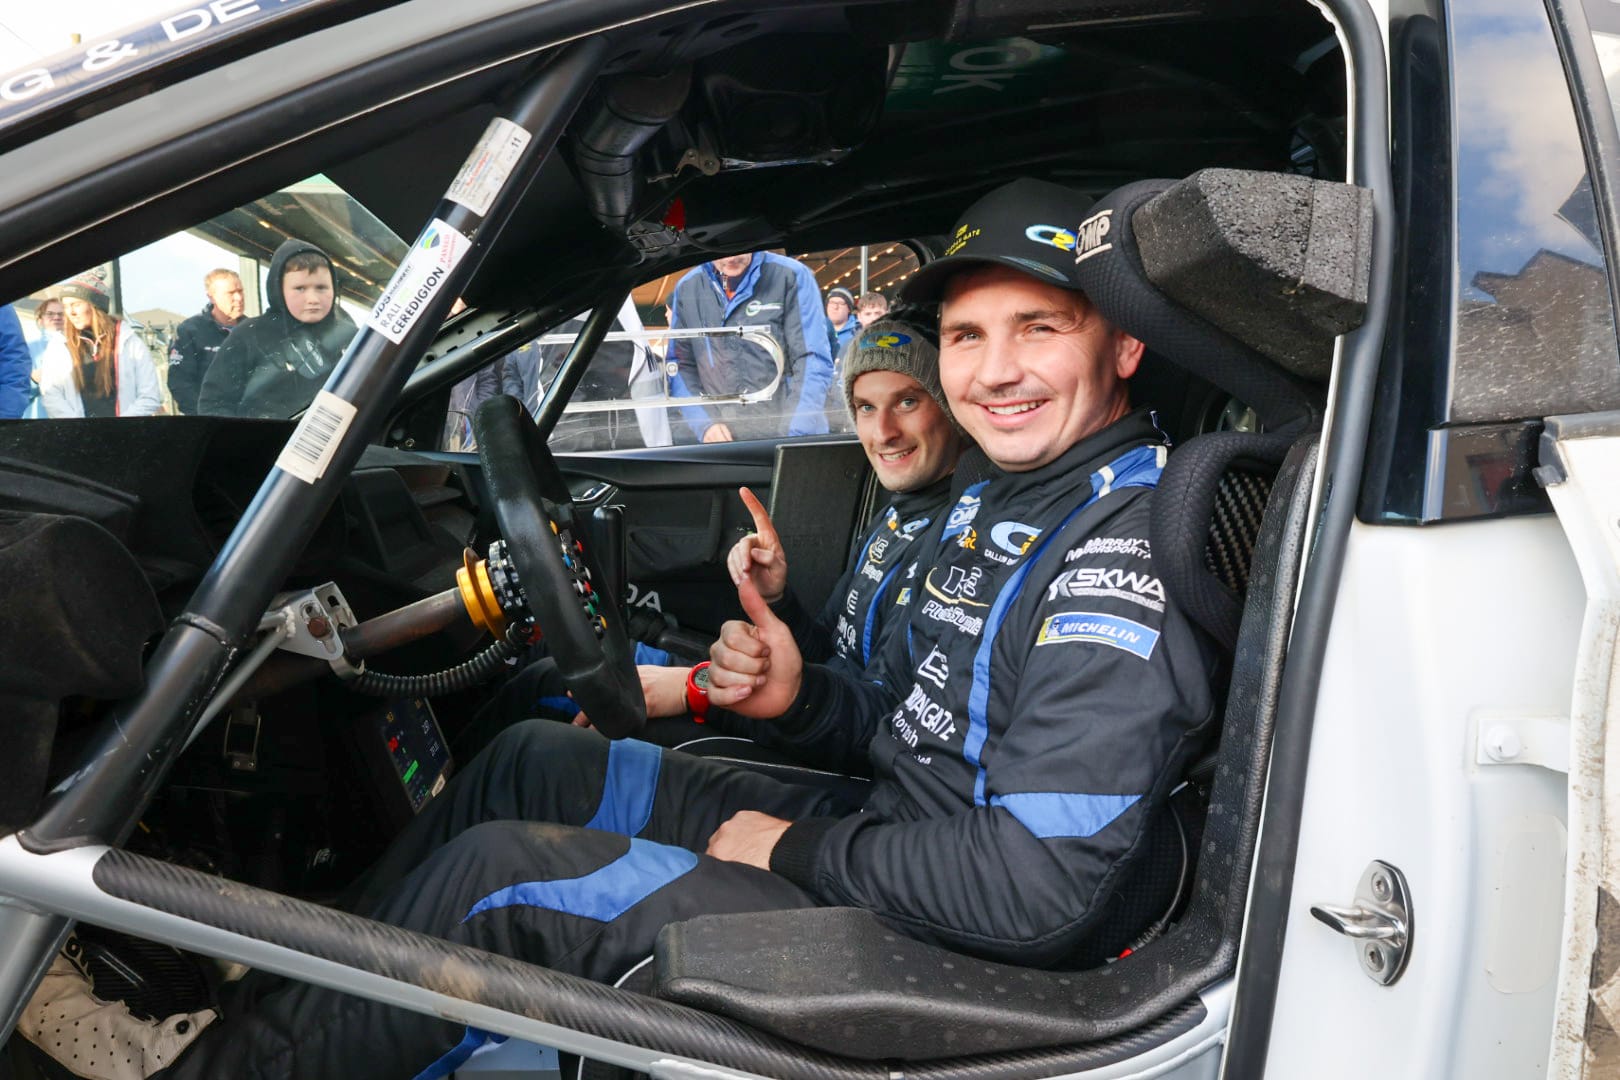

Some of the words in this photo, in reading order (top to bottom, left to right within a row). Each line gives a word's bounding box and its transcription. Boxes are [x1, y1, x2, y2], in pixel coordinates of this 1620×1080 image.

[82, 39, 138, 71] &
[160, 0, 289, 41] DE
[1075, 215, 1111, 257] OMP
[374, 295, 391, 319] JDS
[391, 266, 446, 335] CEREDIGION
[380, 303, 402, 328] RALI
[950, 505, 980, 524] OM
[1061, 622, 1141, 644] MICHELIN
